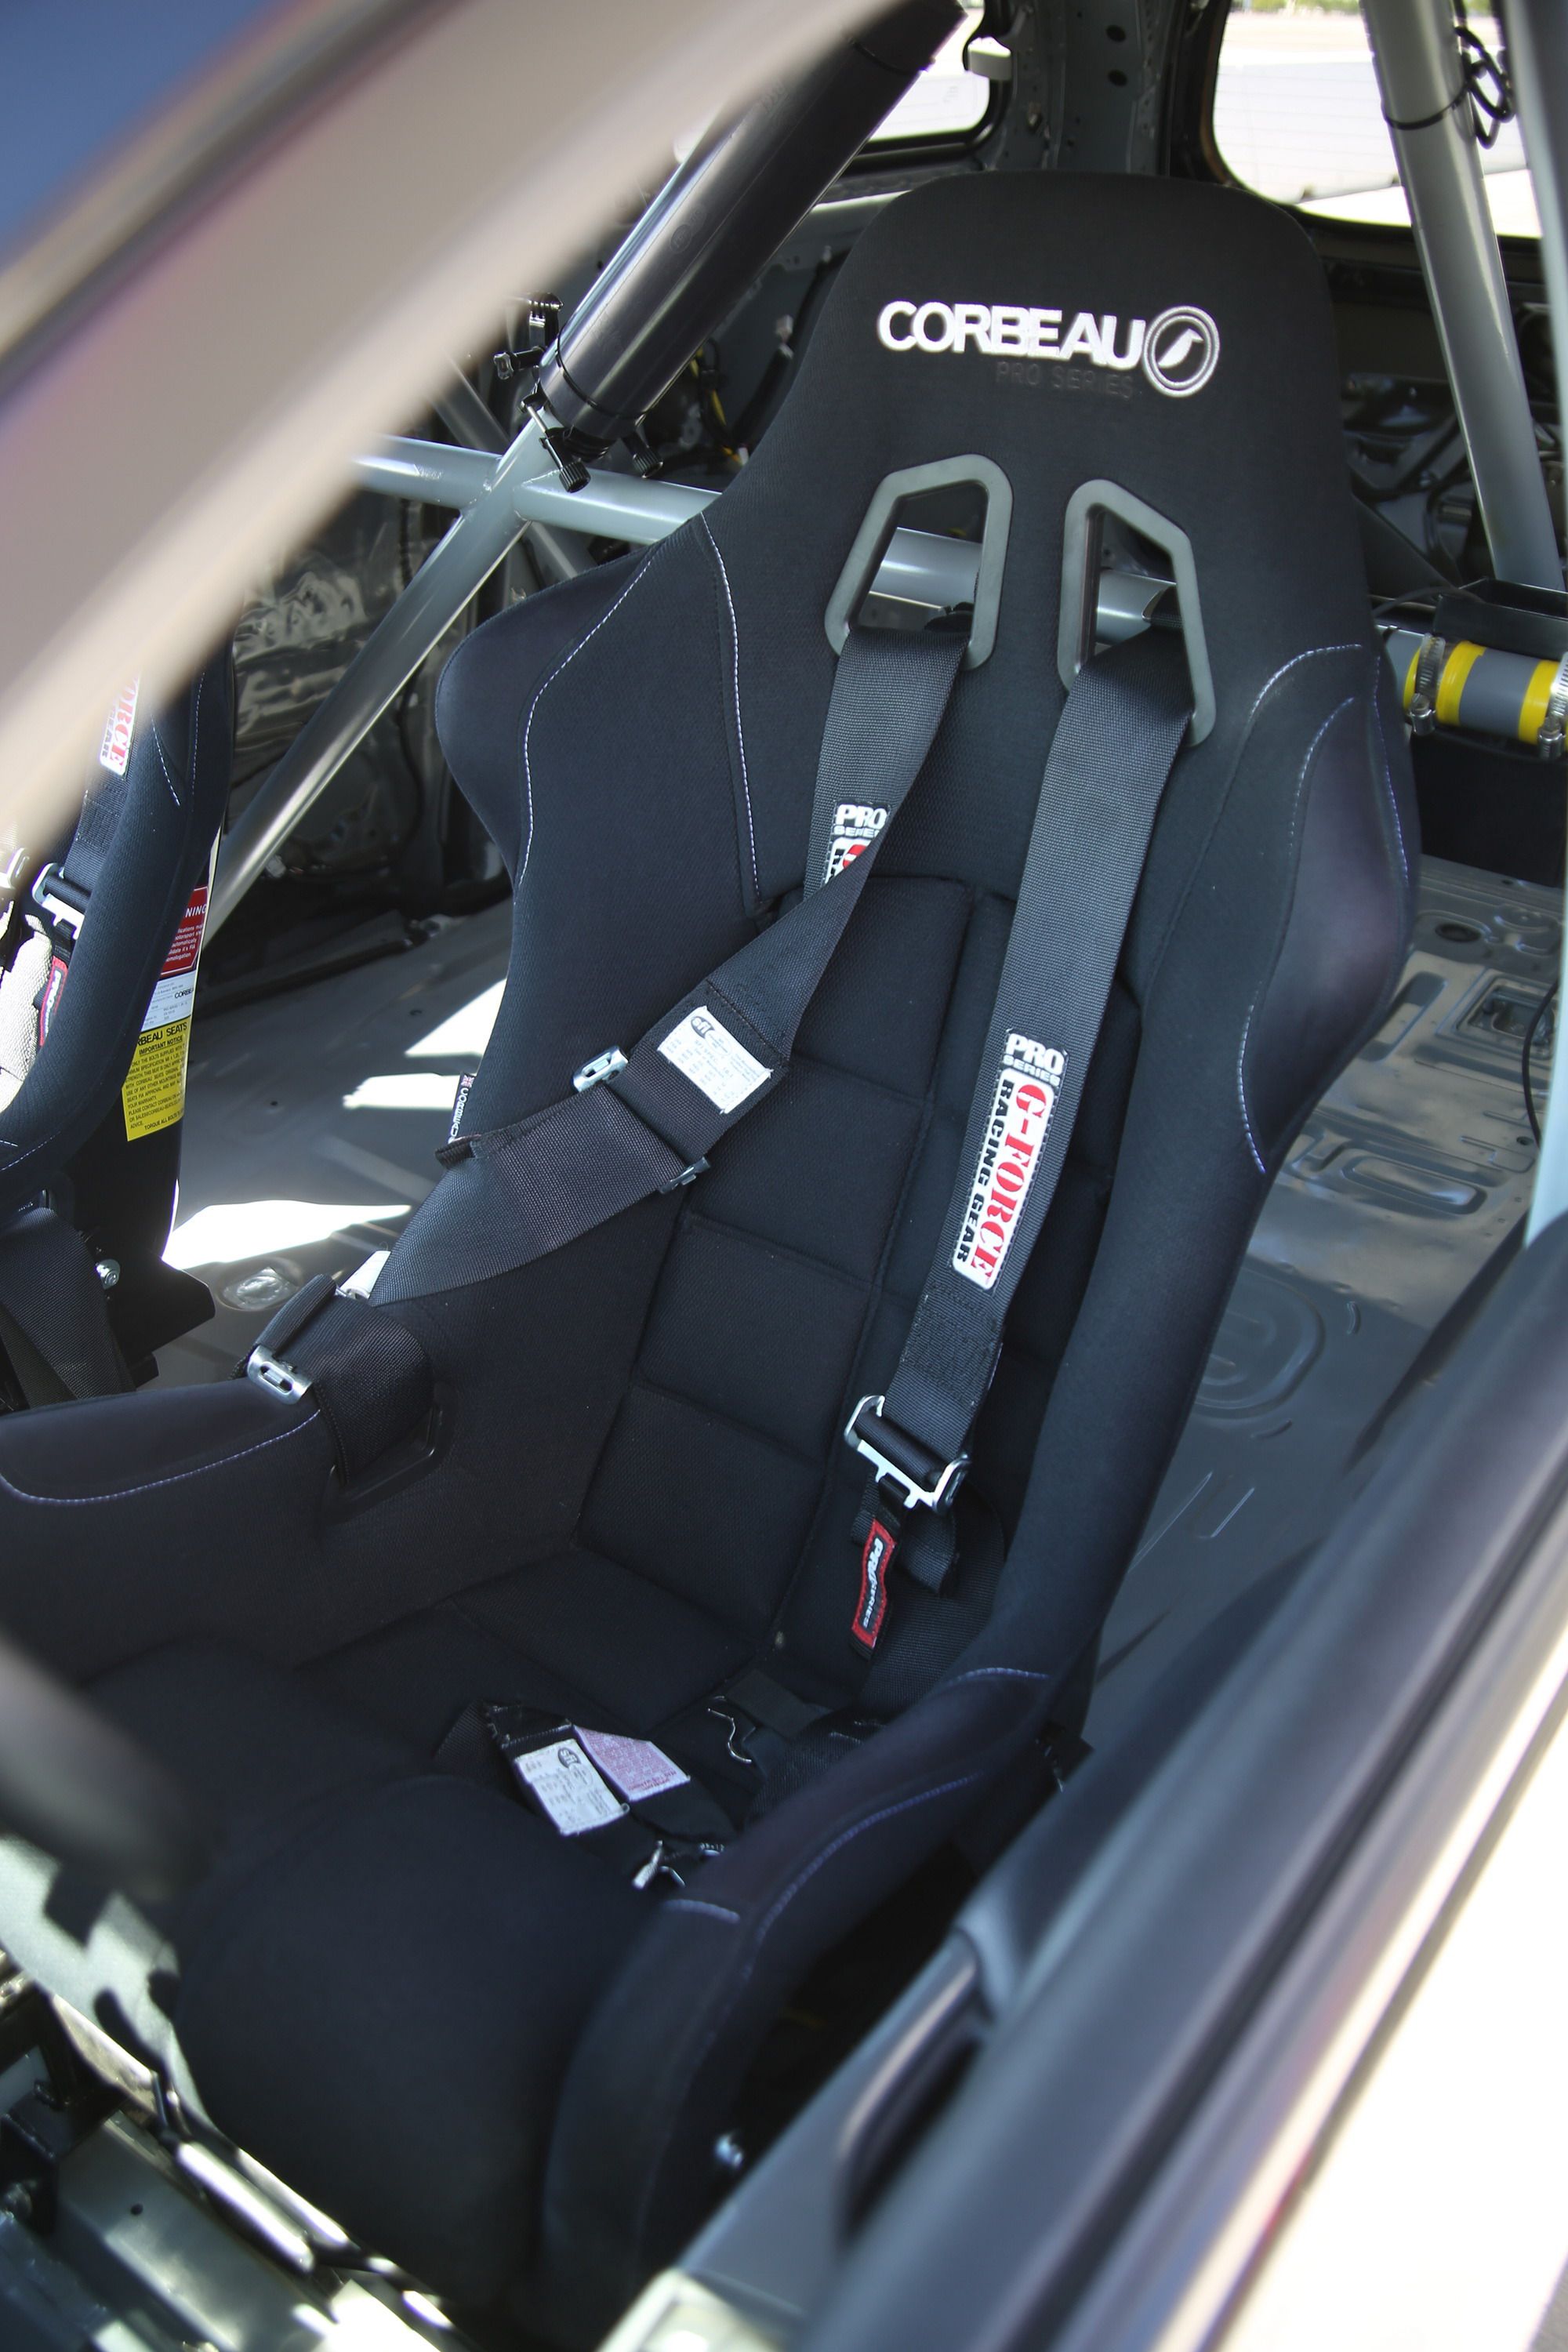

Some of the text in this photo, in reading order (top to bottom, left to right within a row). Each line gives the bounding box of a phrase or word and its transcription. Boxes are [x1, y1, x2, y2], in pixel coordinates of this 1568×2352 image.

[877, 299, 1147, 371] CORBEAU
[996, 361, 1136, 401] PRO SERIES
[835, 804, 888, 830] PRO
[185, 903, 208, 918] NING
[139, 1040, 166, 1054] IMPORTANT
[167, 1036, 183, 1045] NOTICE
[166, 1022, 187, 1036] SEATS
[1003, 1054, 1062, 1087] SERIES
[1005, 1033, 1065, 1076] PRO
[450, 1087, 469, 1138] CORBEAU
[956, 1079, 1015, 1264] RACING GEAR
[971, 1083, 1047, 1279] G-FORCE
